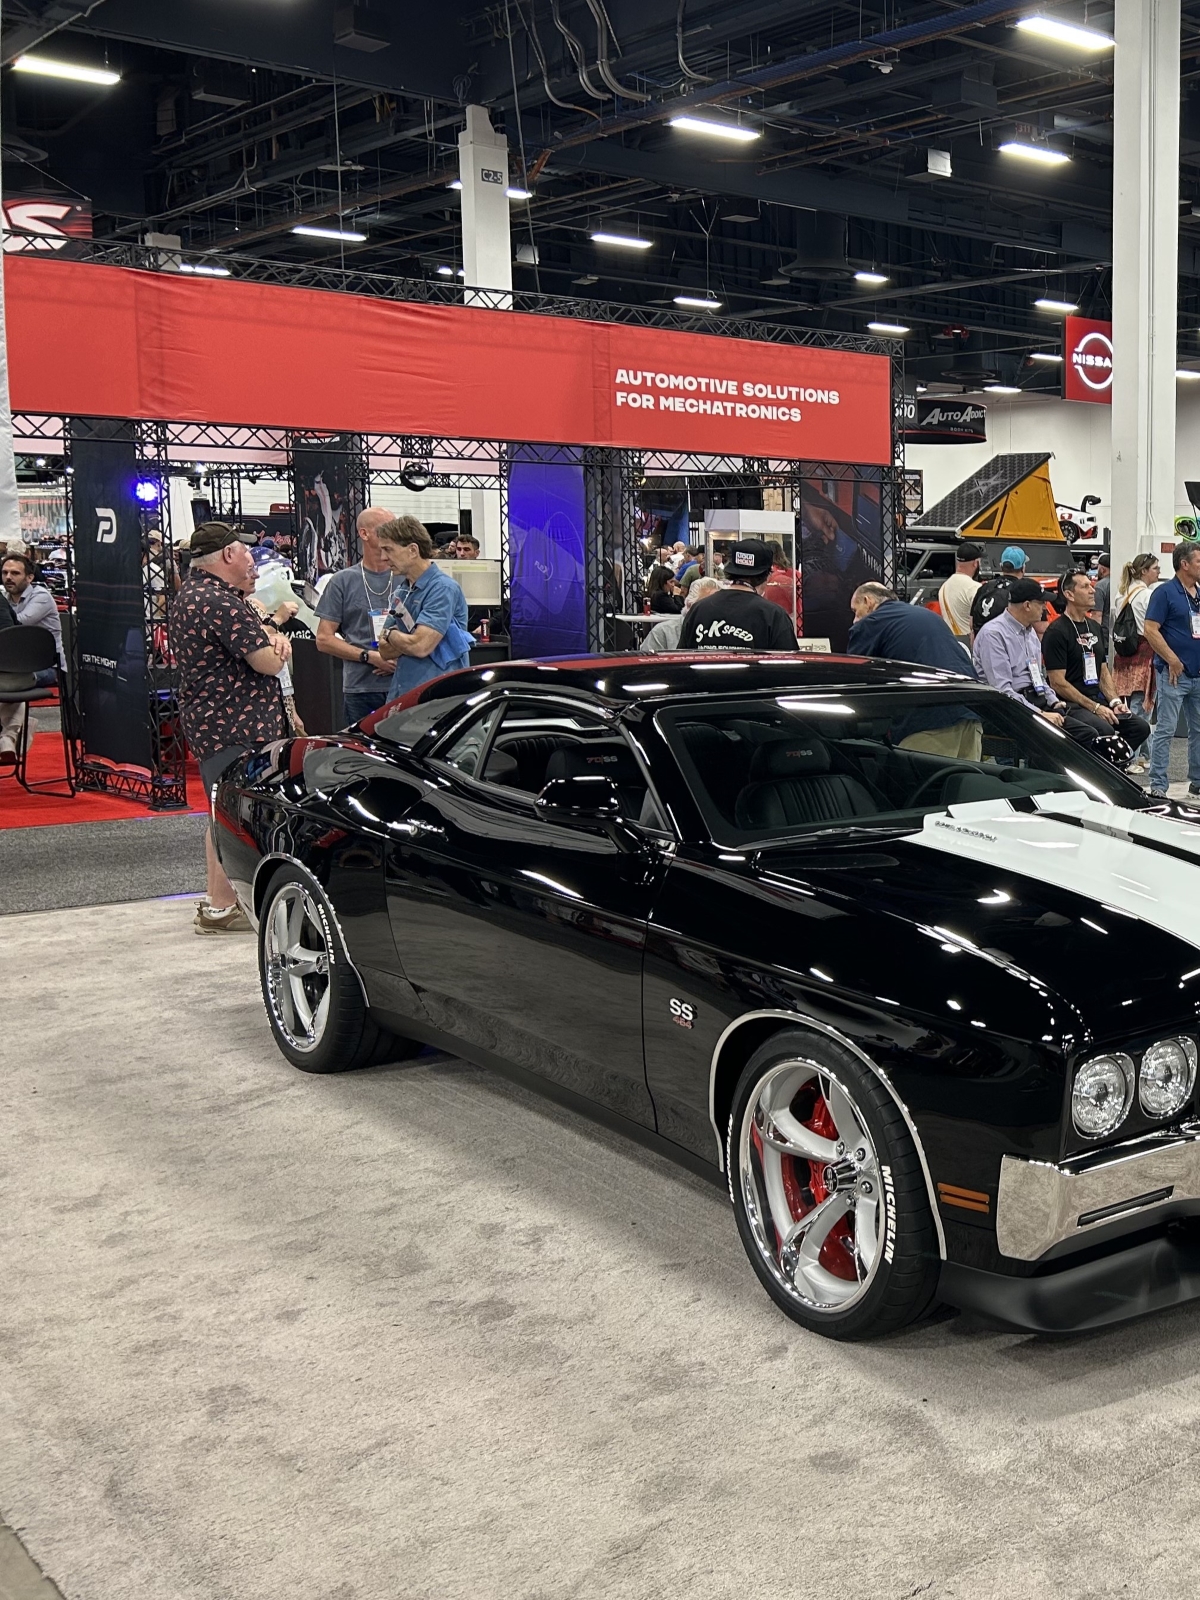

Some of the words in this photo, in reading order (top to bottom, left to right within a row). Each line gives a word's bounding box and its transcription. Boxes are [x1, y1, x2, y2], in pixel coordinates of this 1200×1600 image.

[482, 170, 502, 183] C2-5
[1072, 352, 1113, 368] NISSA
[615, 368, 739, 395] AUTOMOTIVE
[742, 382, 840, 405] SOLUTIONS
[616, 391, 655, 409] FOR
[659, 396, 802, 422] MECHATRONICS
[722, 624, 754, 642] SPEED
[317, 903, 336, 965] MICHELIN
[669, 997, 695, 1021] SS
[880, 1164, 898, 1266] MICHELIN
